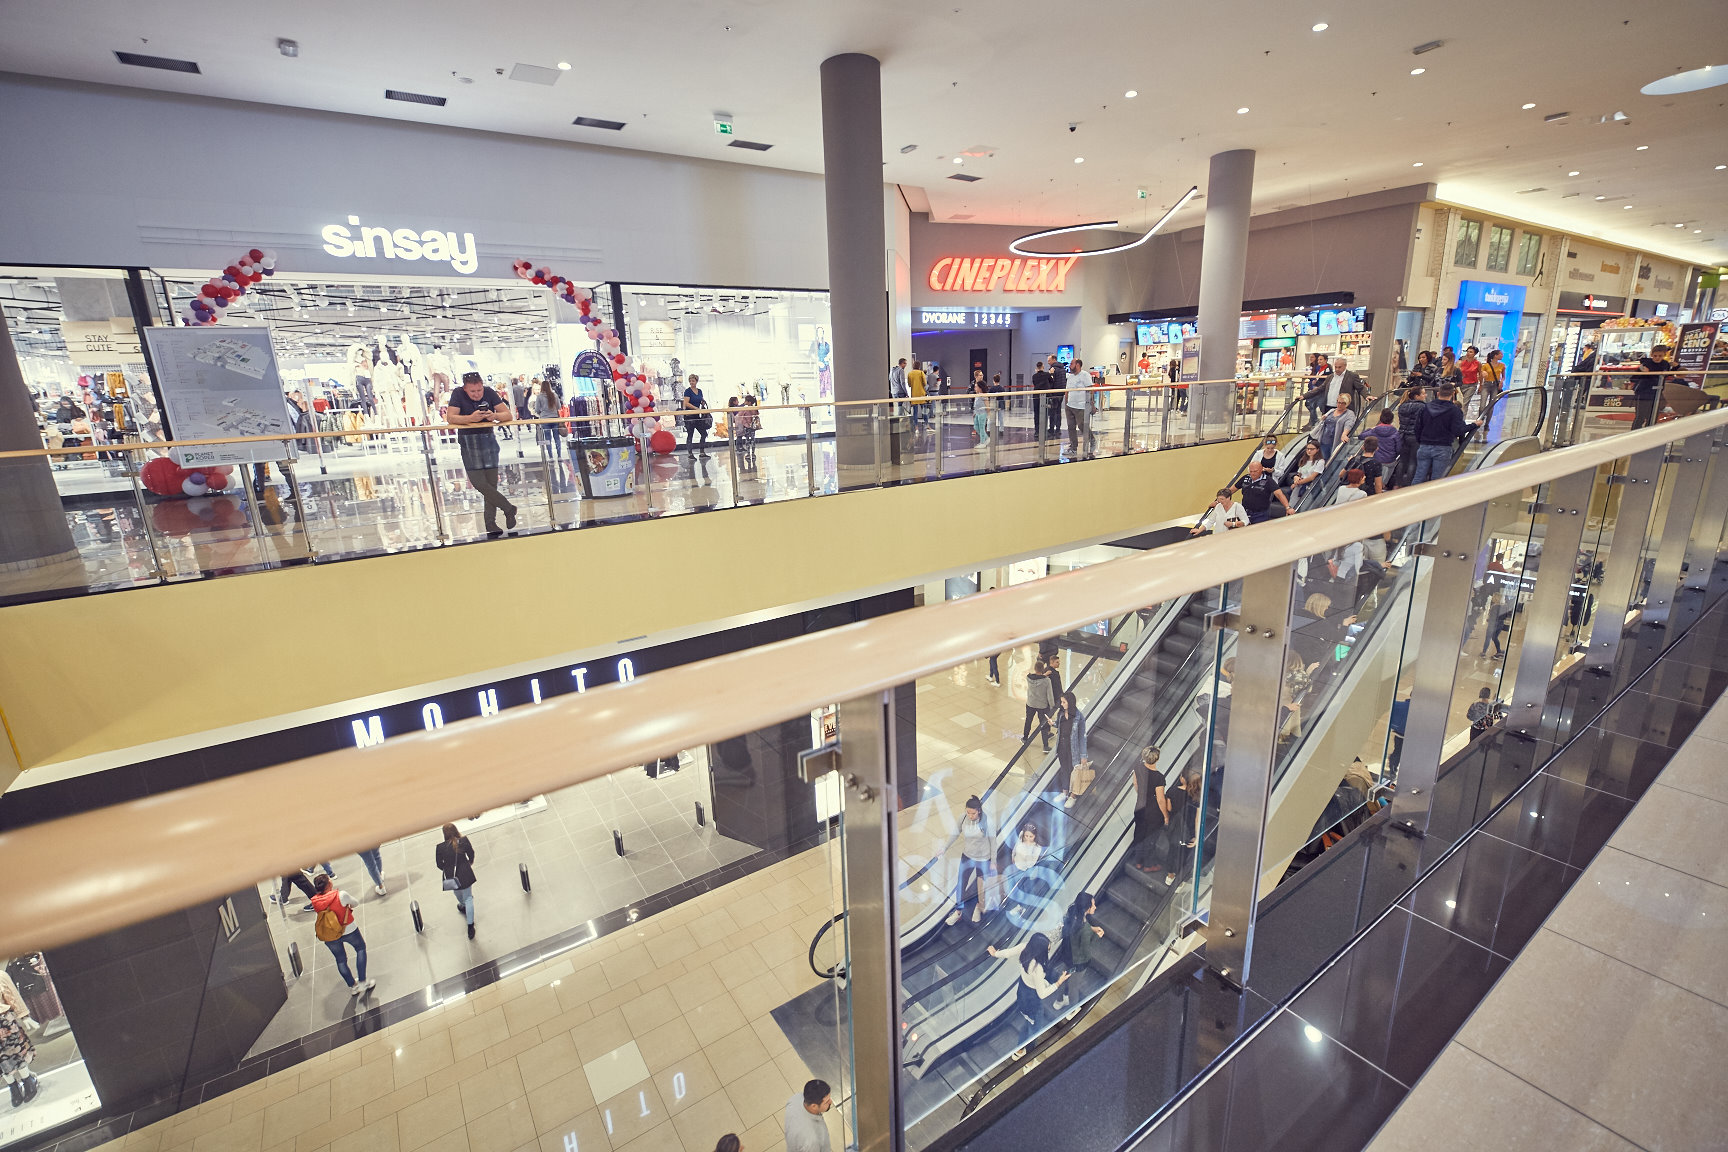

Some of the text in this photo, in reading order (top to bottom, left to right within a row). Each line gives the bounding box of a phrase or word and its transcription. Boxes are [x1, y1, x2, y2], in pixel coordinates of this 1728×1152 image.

[321, 215, 478, 274] sinsay
[929, 250, 1082, 291] CINEPLEXX
[921, 312, 966, 324] DVORANE
[981, 314, 988, 324] 2
[989, 314, 996, 324] 3
[996, 314, 1003, 324] 4
[1004, 314, 1011, 324] 5
[84, 334, 109, 342] STAY
[85, 343, 112, 351] CUTE
[351, 658, 635, 749] MOHITO
